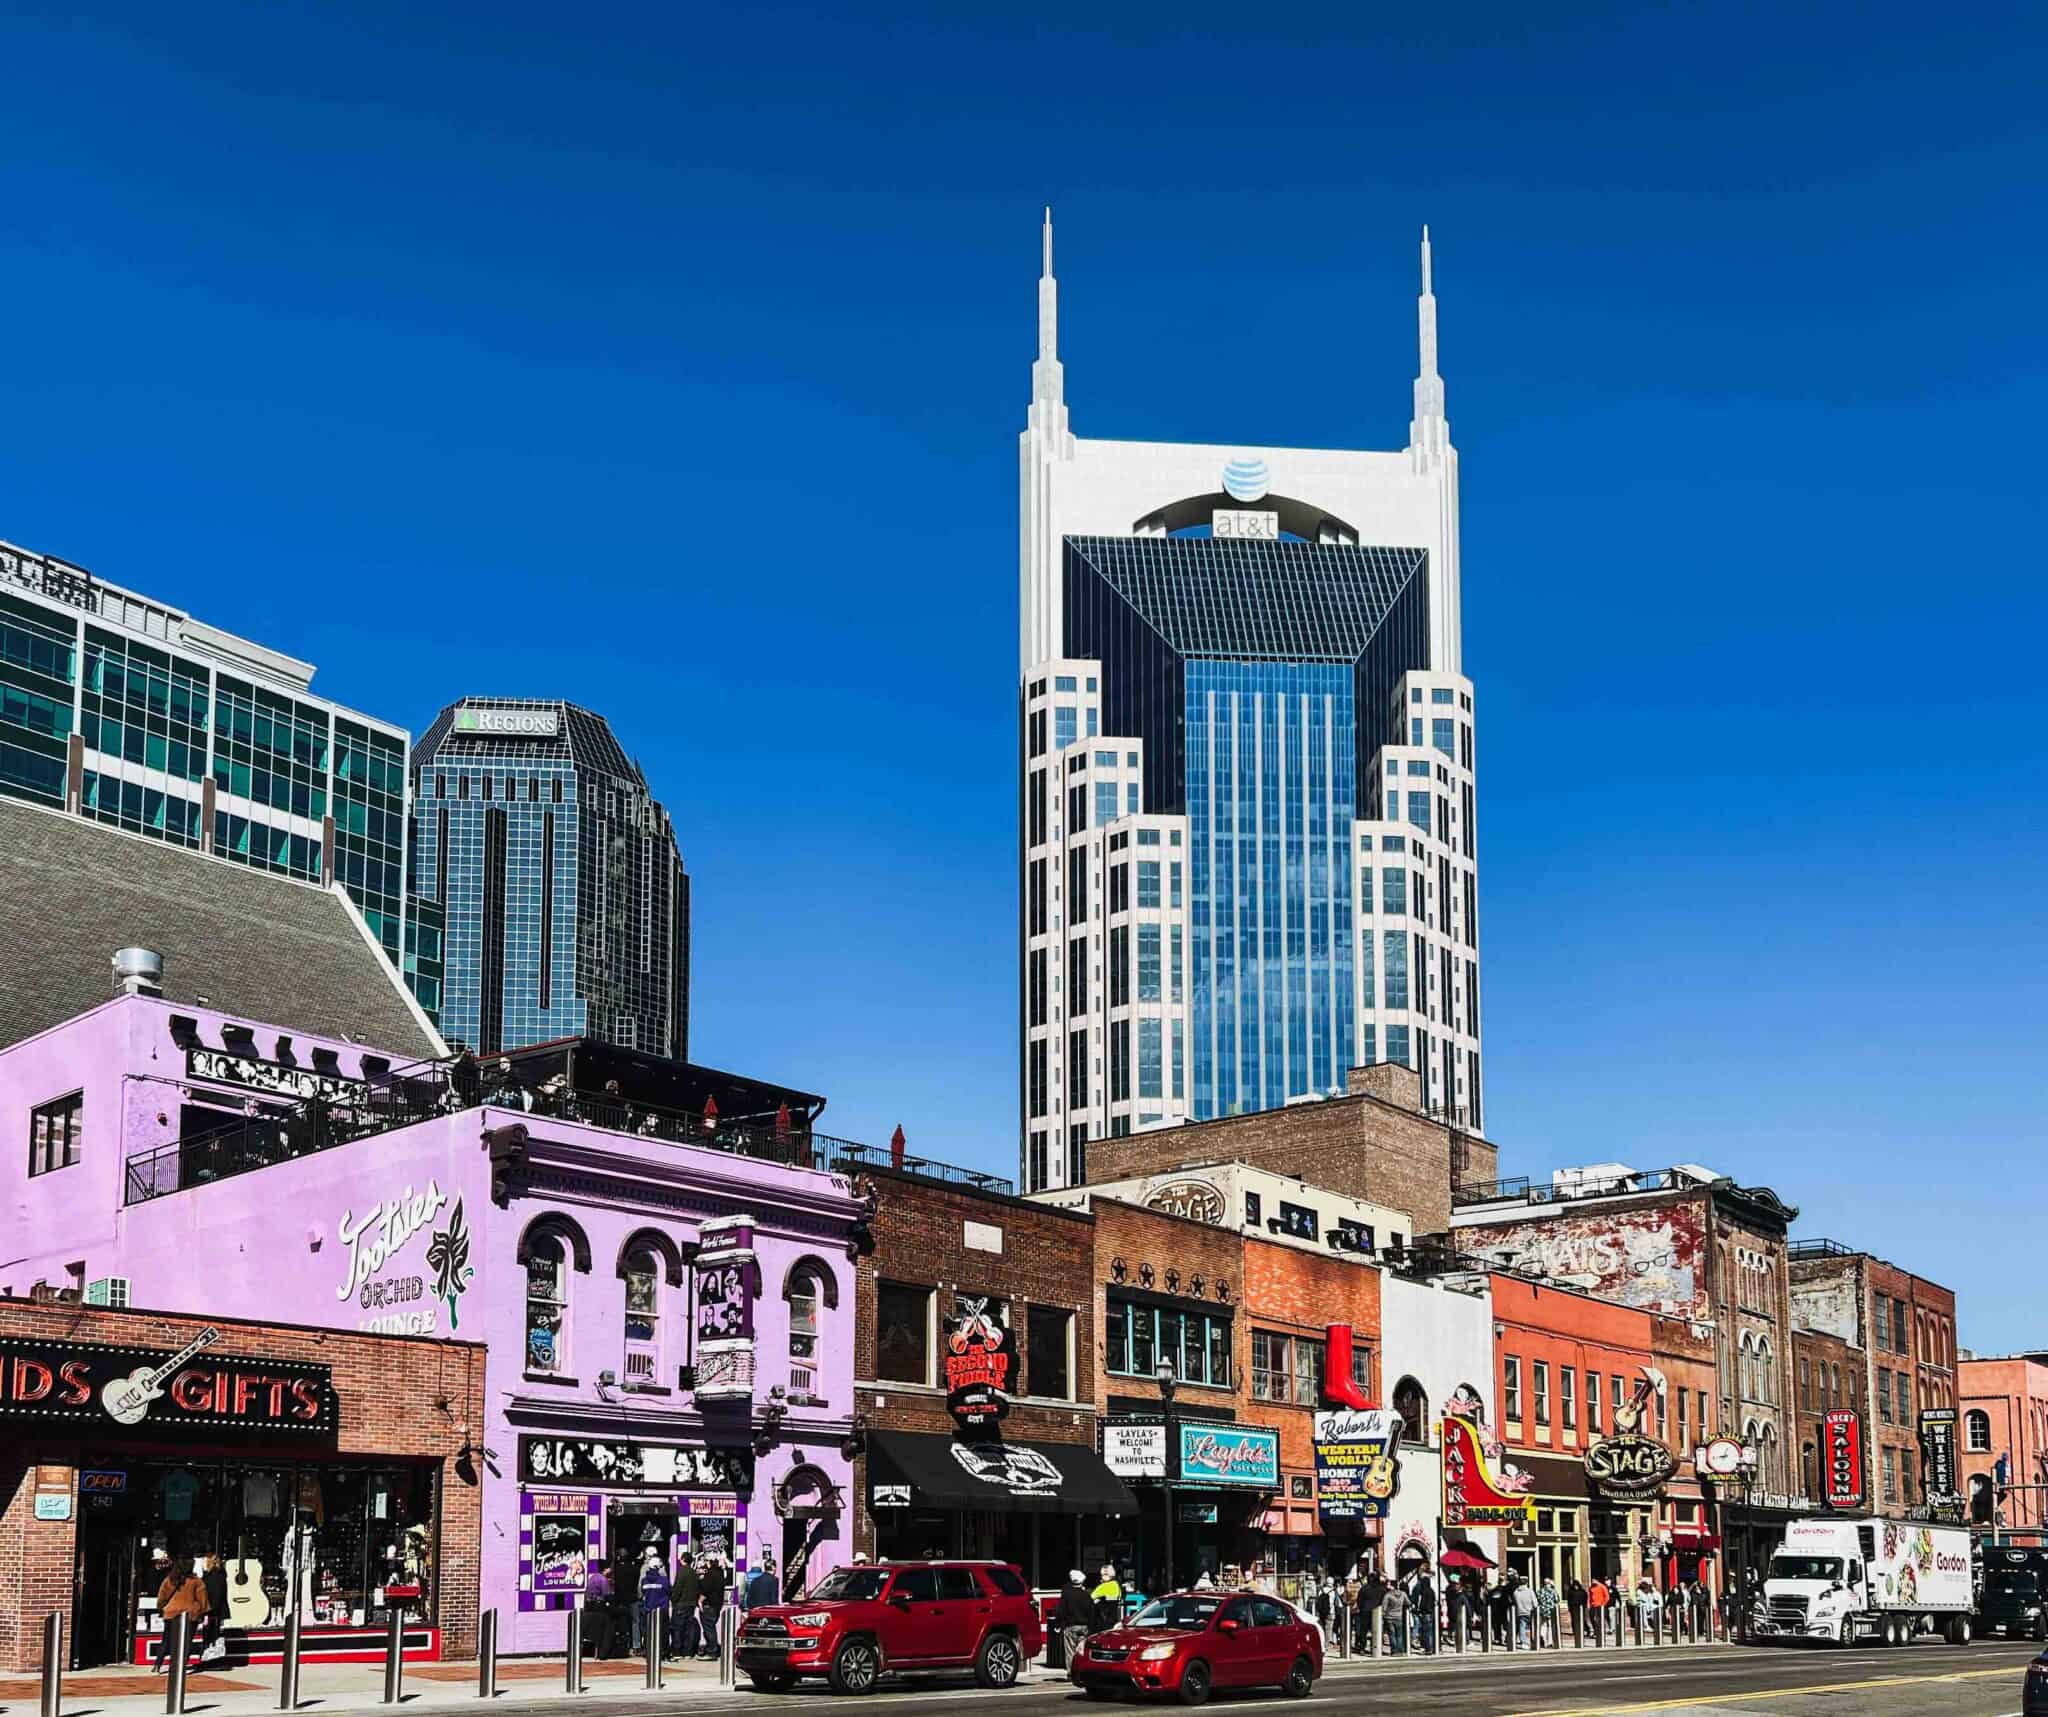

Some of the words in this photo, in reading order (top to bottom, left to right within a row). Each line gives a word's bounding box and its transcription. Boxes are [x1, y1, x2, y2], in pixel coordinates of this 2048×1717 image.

[1215, 512, 1276, 537] at&t
[479, 711, 555, 732] REGIONS
[336, 1177, 448, 1302] Tootsies
[360, 1276, 423, 1309] ORCHID
[0, 1354, 91, 1406] DS
[171, 1369, 319, 1420] GIFTS
[1115, 1457, 1155, 1465] NASHVILLE
[1317, 1444, 1381, 1455] WESTERN
[1325, 1455, 1373, 1466] WORLD
[1589, 1443, 1670, 1479] STAGE
[1833, 1423, 1851, 1494] SALOON
[1933, 1424, 1948, 1494] WHISKEY
[1319, 1468, 1357, 1479] HOME
[533, 1495, 559, 1511] WORLD
[560, 1496, 589, 1512] FAMOUS
[1936, 1551, 1968, 1572] Gordon
